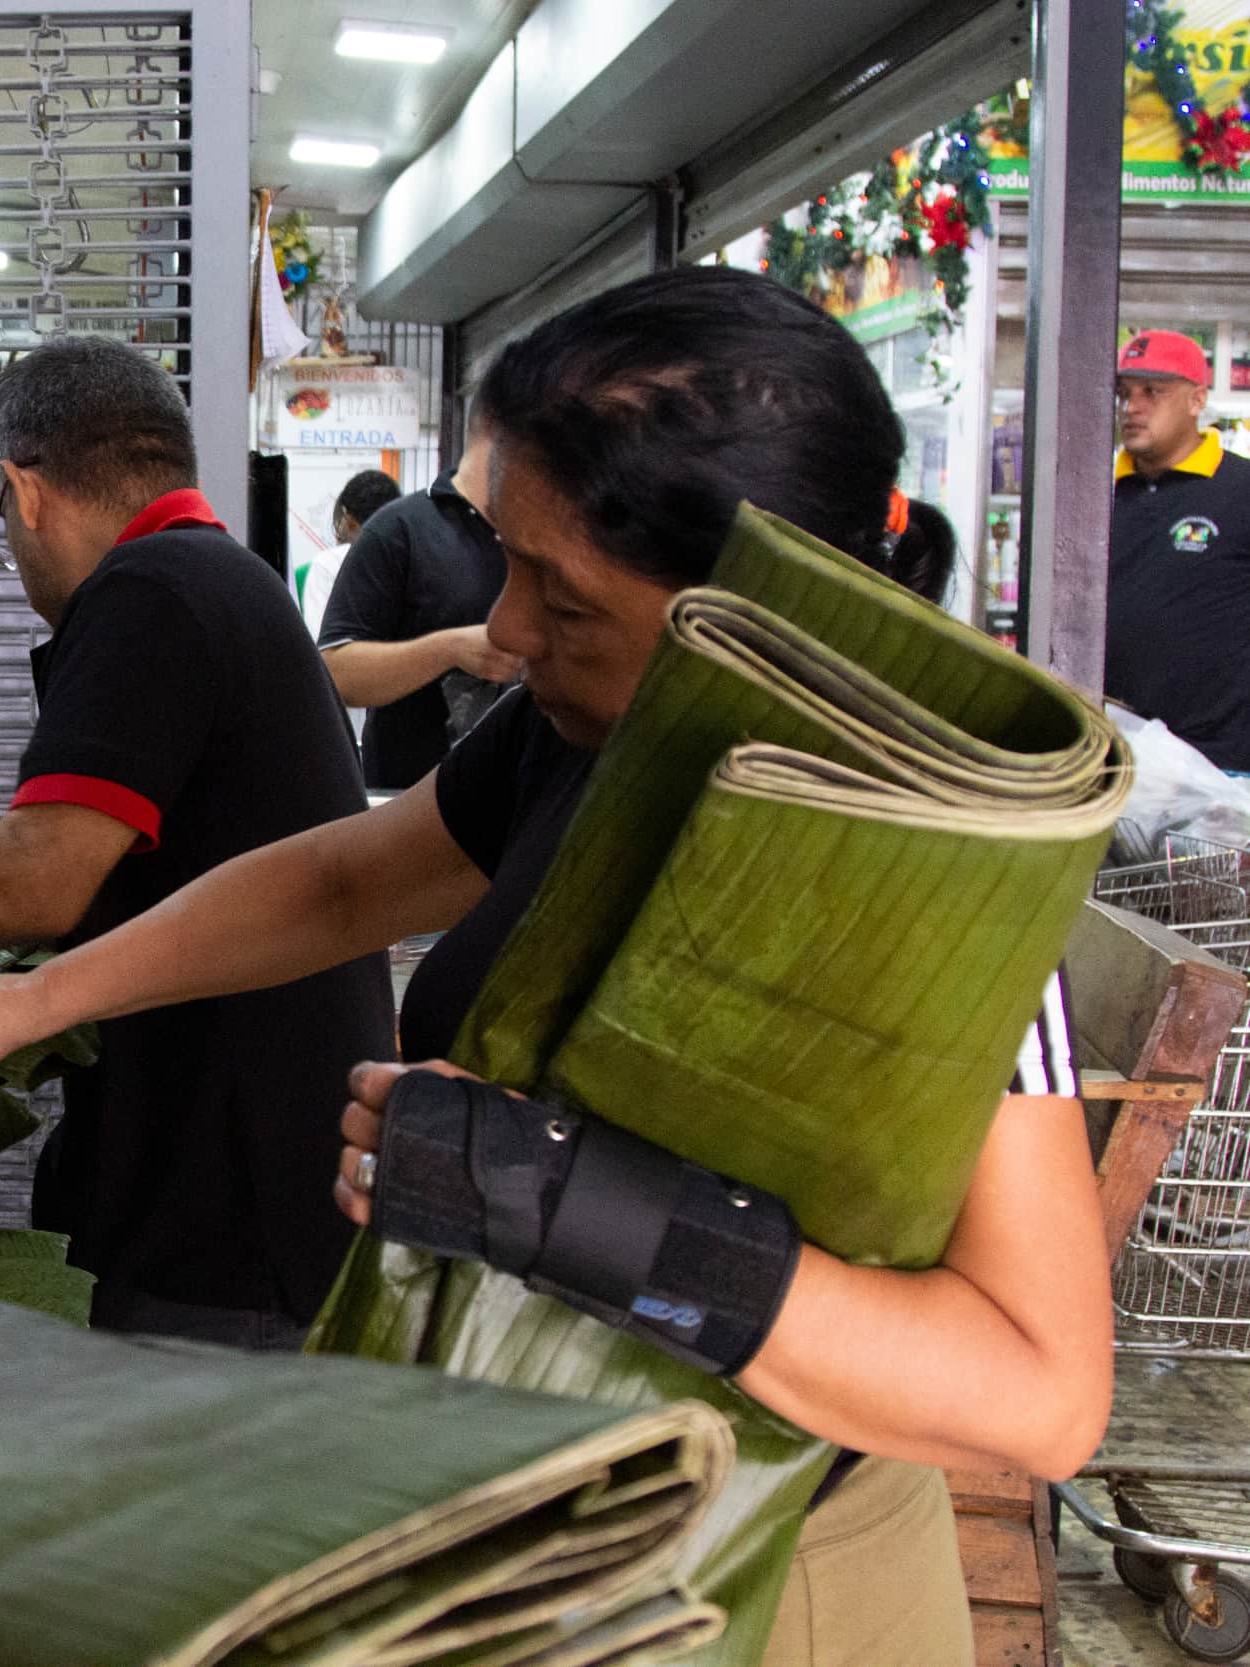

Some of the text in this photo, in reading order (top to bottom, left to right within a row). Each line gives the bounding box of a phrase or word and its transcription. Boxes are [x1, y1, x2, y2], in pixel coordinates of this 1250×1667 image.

[1122, 171, 1197, 193] limentos
[294, 367, 405, 384] BIENVENIDOS
[299, 430, 397, 446] ENTRADA
